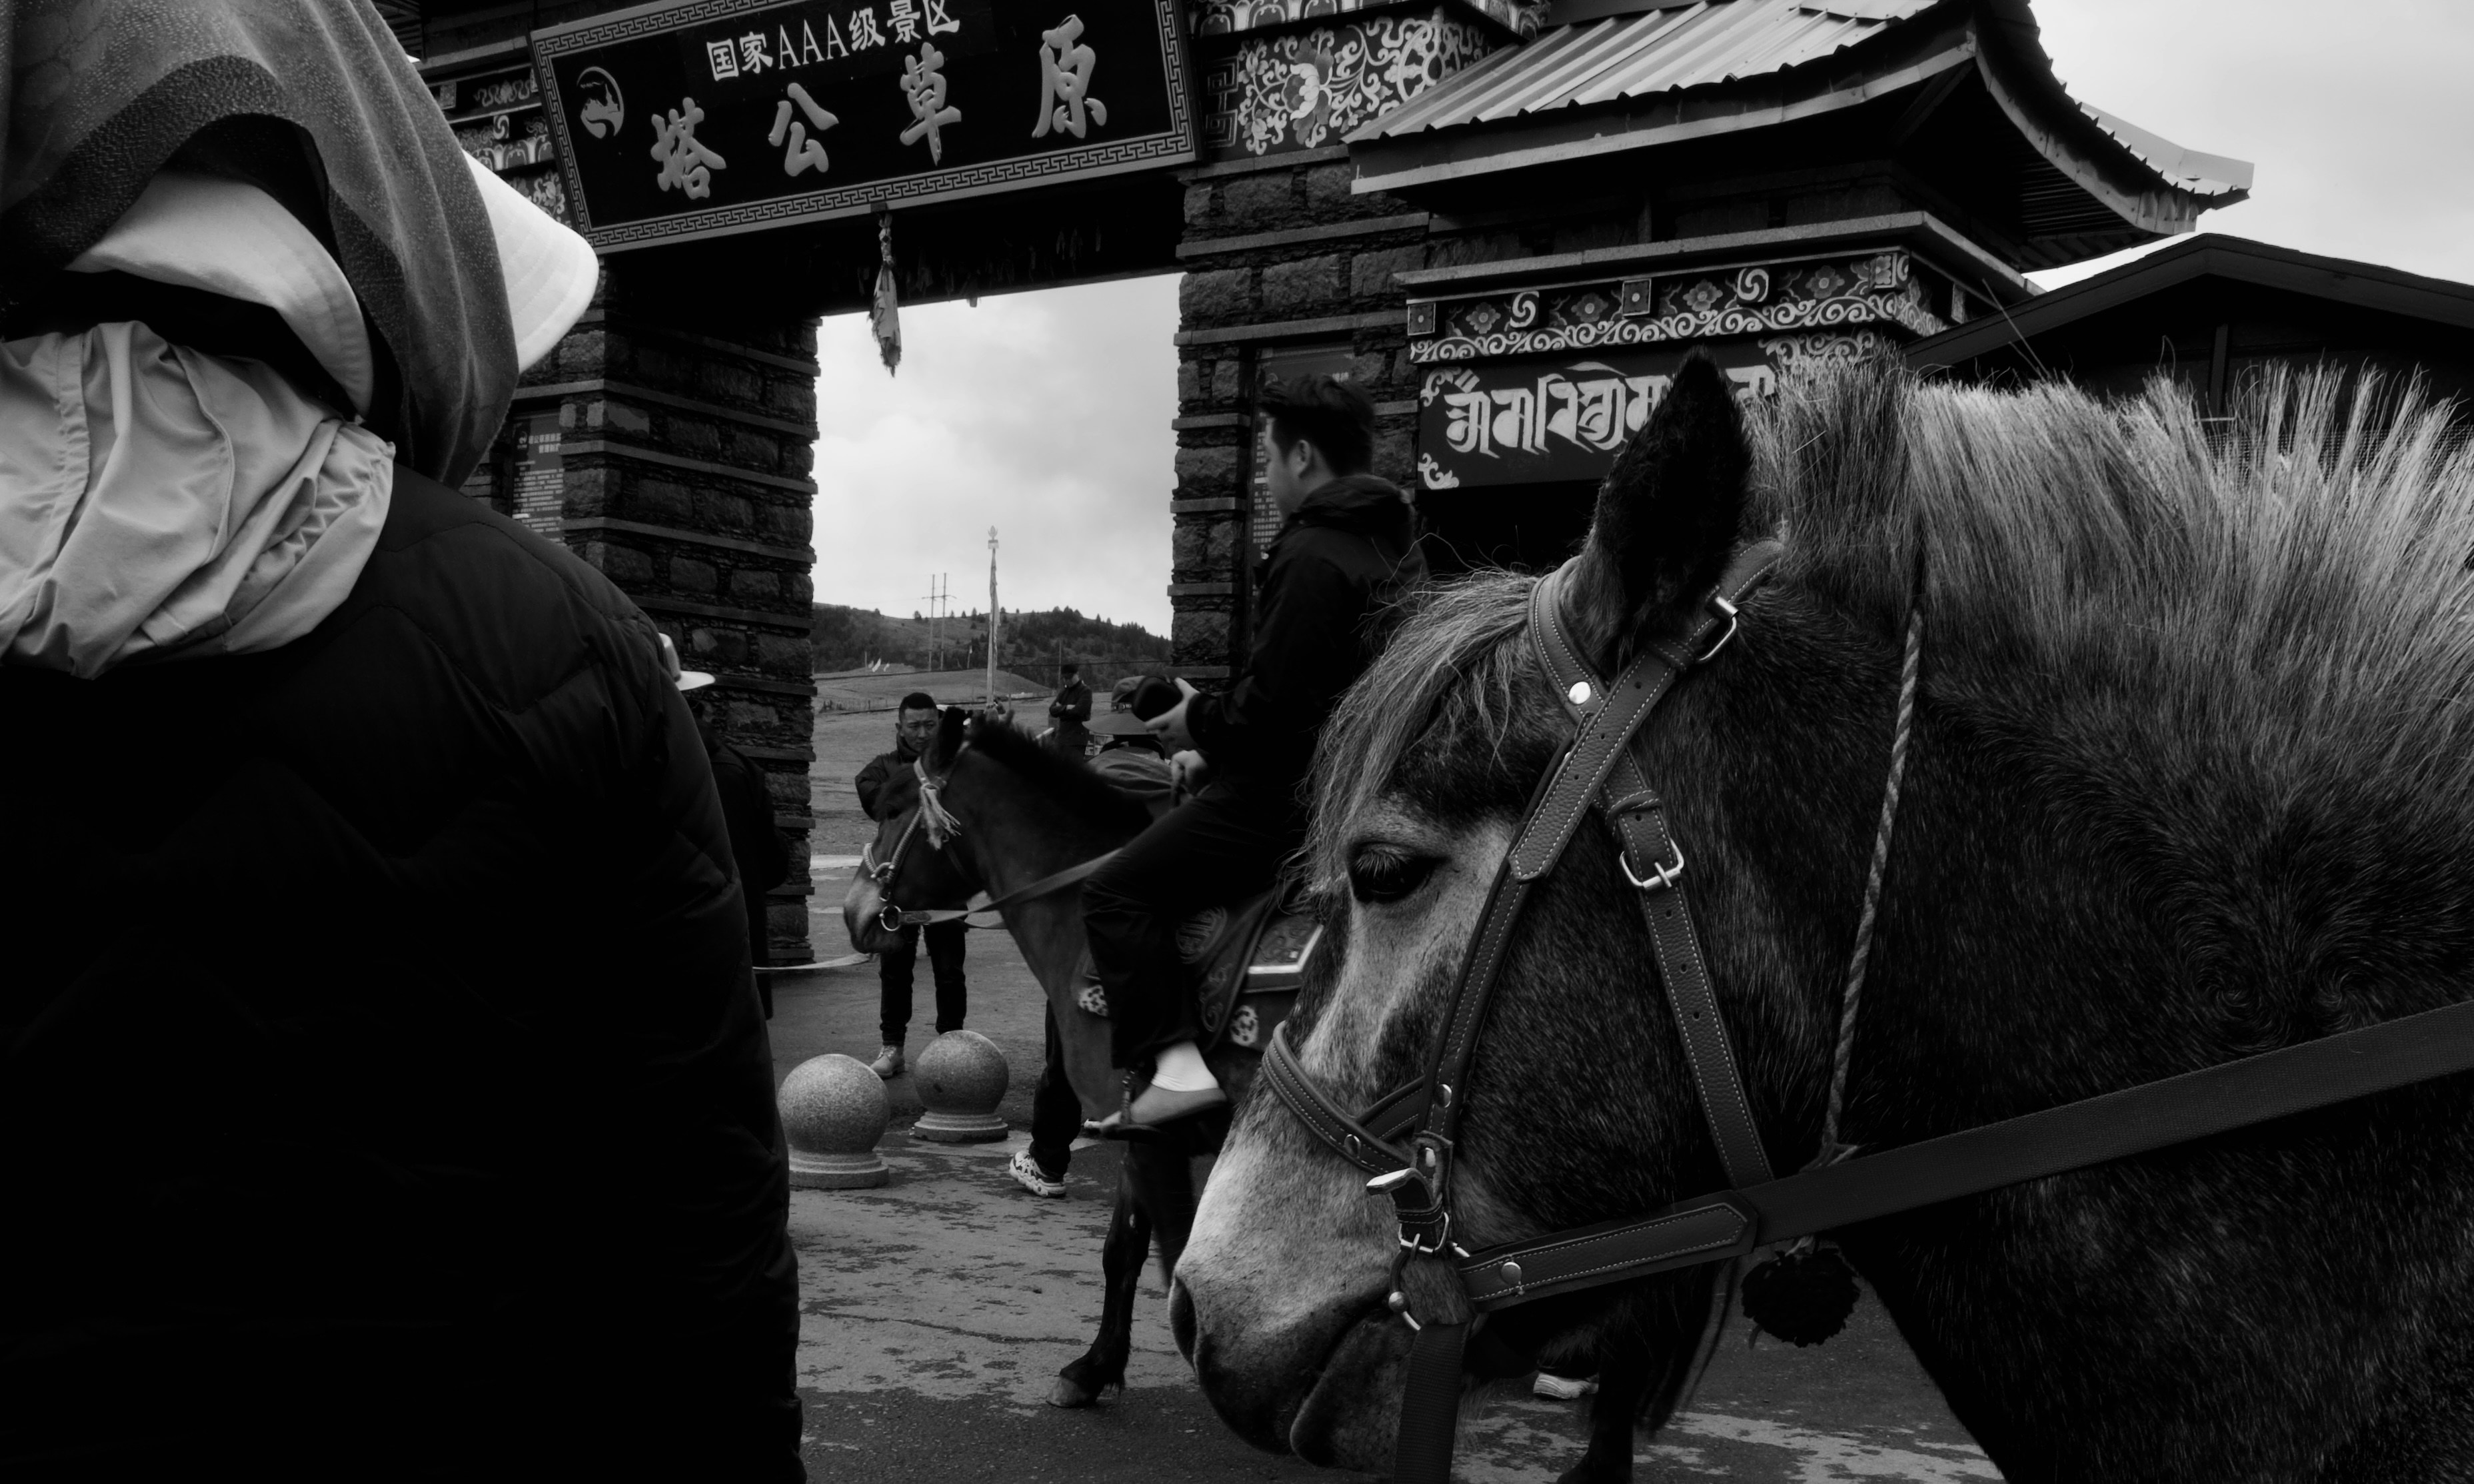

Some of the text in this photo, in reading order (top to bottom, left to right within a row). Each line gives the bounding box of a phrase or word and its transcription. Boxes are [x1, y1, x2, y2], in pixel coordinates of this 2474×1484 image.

[651, 14, 1108, 199] 塔公草原
[706, 0, 960, 81] 国家AAA级景区
